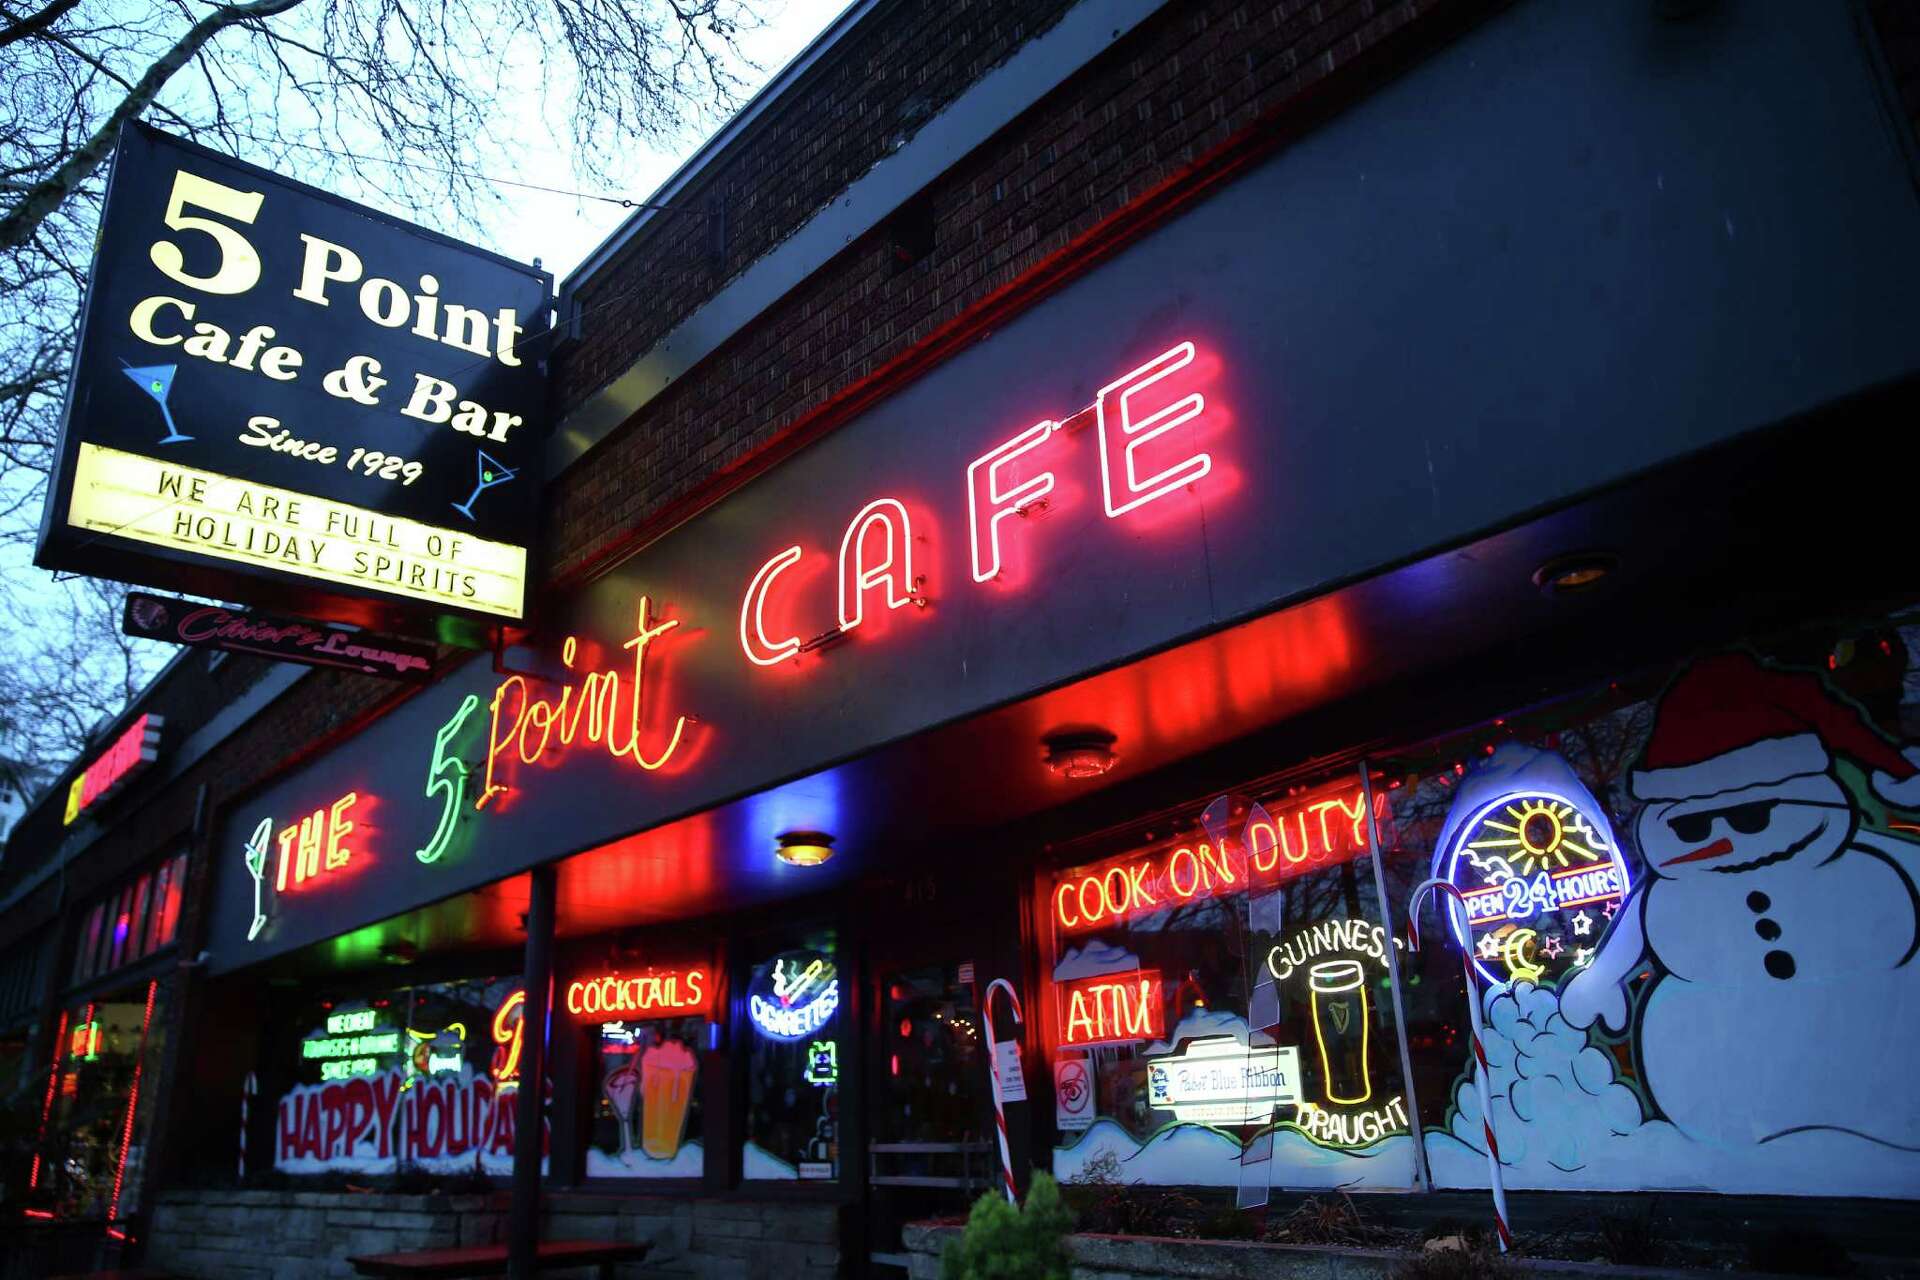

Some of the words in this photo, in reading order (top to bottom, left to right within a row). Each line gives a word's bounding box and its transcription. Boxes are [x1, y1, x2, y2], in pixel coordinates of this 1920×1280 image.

[150, 169, 264, 295] 5
[293, 233, 522, 366] Point
[129, 296, 303, 380] Cafe
[323, 356, 387, 405] &
[401, 373, 522, 443] Bar
[239, 416, 337, 464] Since
[347, 447, 423, 486] 1929
[158, 470, 208, 504] WE
[236, 490, 302, 525] ARE
[325, 511, 400, 548] FULL
[427, 534, 465, 561] OF
[173, 511, 327, 564] HOLIDAY
[353, 551, 477, 598] SPIRITS
[276, 792, 357, 891] THE
[416, 695, 478, 863] 5
[740, 341, 1211, 666] CAFE
[1058, 861, 1156, 927] COOK
[1170, 837, 1235, 896] ON
[1250, 791, 1367, 872] DUTY
[1503, 871, 1559, 918] 24
[1556, 868, 1620, 899] HOURS
[567, 971, 703, 1014] COCKTAILS
[1067, 979, 1152, 1042] ATM
[278, 1073, 401, 1161] HAPPY
[405, 1077, 551, 1159] HOLIDA
[1211, 1069, 1237, 1091] Blue
[1240, 1065, 1286, 1089] Ribbon
[1296, 1096, 1409, 1144] DRAUGHT
